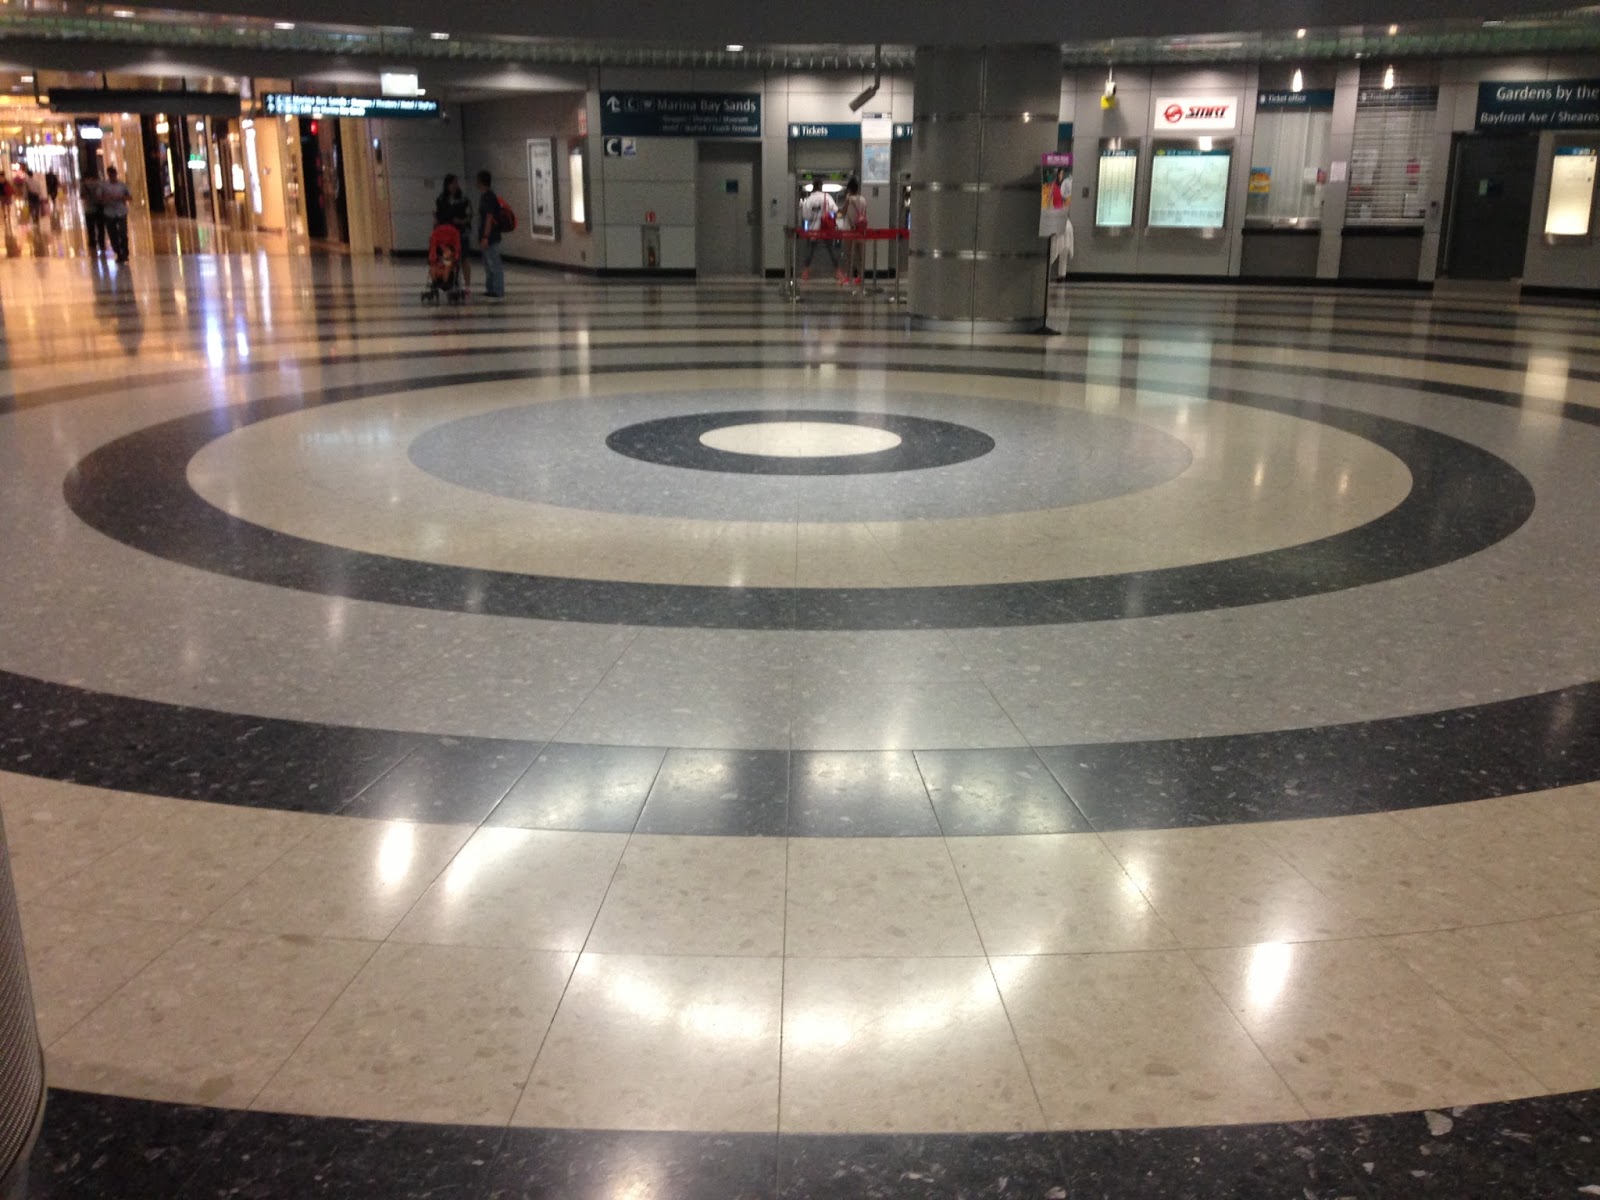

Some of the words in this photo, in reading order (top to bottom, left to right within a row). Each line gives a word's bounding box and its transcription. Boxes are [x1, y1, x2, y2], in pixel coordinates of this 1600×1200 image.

[1269, 94, 1287, 103] Ticket
[1288, 93, 1306, 103] office
[1496, 85, 1552, 101] Gardens
[1556, 84, 1573, 102] by
[1577, 85, 1600, 99] the
[657, 99, 697, 112] Marina
[701, 99, 721, 114] Bay
[723, 98, 757, 113] Sands
[1184, 105, 1230, 119] SMRT
[1480, 110, 1526, 124] Bayfront
[1528, 111, 1548, 122] Ave
[1558, 110, 1600, 123] Sheares
[802, 125, 829, 137] Tickets
[606, 138, 619, 155] C
